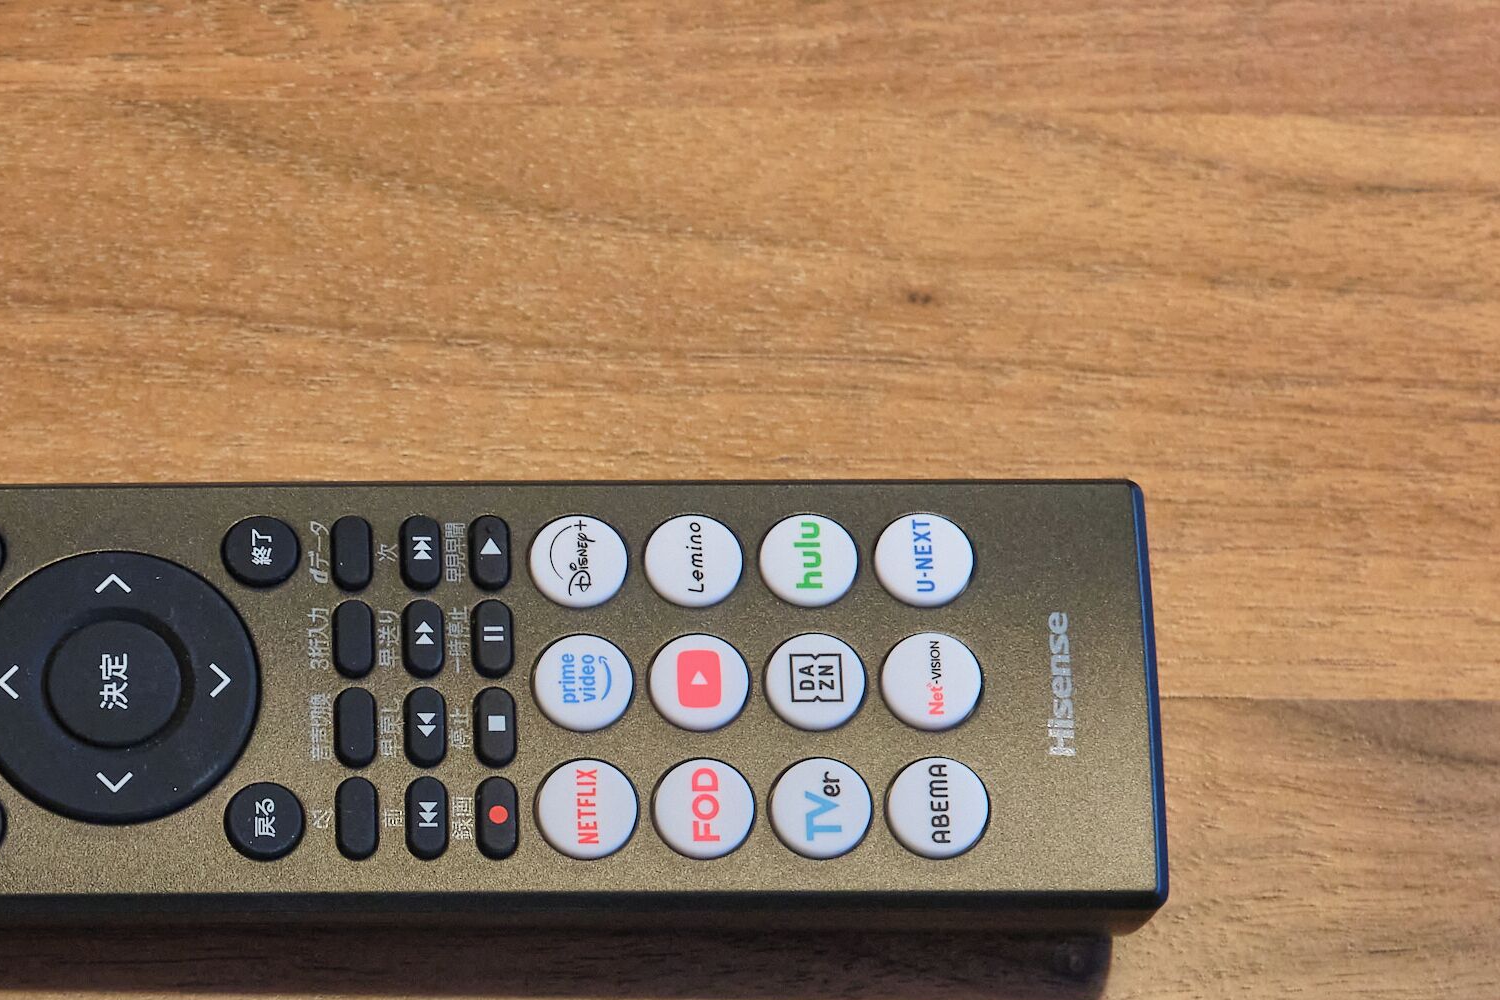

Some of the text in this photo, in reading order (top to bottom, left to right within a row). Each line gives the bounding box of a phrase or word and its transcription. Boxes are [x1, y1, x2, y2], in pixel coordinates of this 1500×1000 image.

[252, 528, 273, 565] 終了
[309, 521, 328, 583] dデータ
[377, 544, 397, 562] 次
[445, 522, 466, 583] 早見早聞
[684, 522, 705, 593] Lemino
[793, 521, 823, 589] hulu
[912, 519, 936, 592] U-NEXT
[309, 607, 329, 670] 3桁入力
[379, 609, 398, 667] 早送り
[447, 606, 469, 673] 一時停止
[100, 653, 129, 710] 決定
[558, 653, 578, 704] prime
[576, 653, 597, 702] video
[1046, 612, 1076, 756] Hisense
[311, 692, 330, 761] 音声切換
[449, 707, 469, 750] 停止
[255, 798, 275, 838] 戻る
[383, 808, 403, 827] 前
[451, 796, 473, 840] 録画
[576, 769, 600, 844] NETFLIX
[691, 768, 719, 842] FOD
[804, 771, 842, 841] TVer
[930, 763, 950, 843] ABEMA
